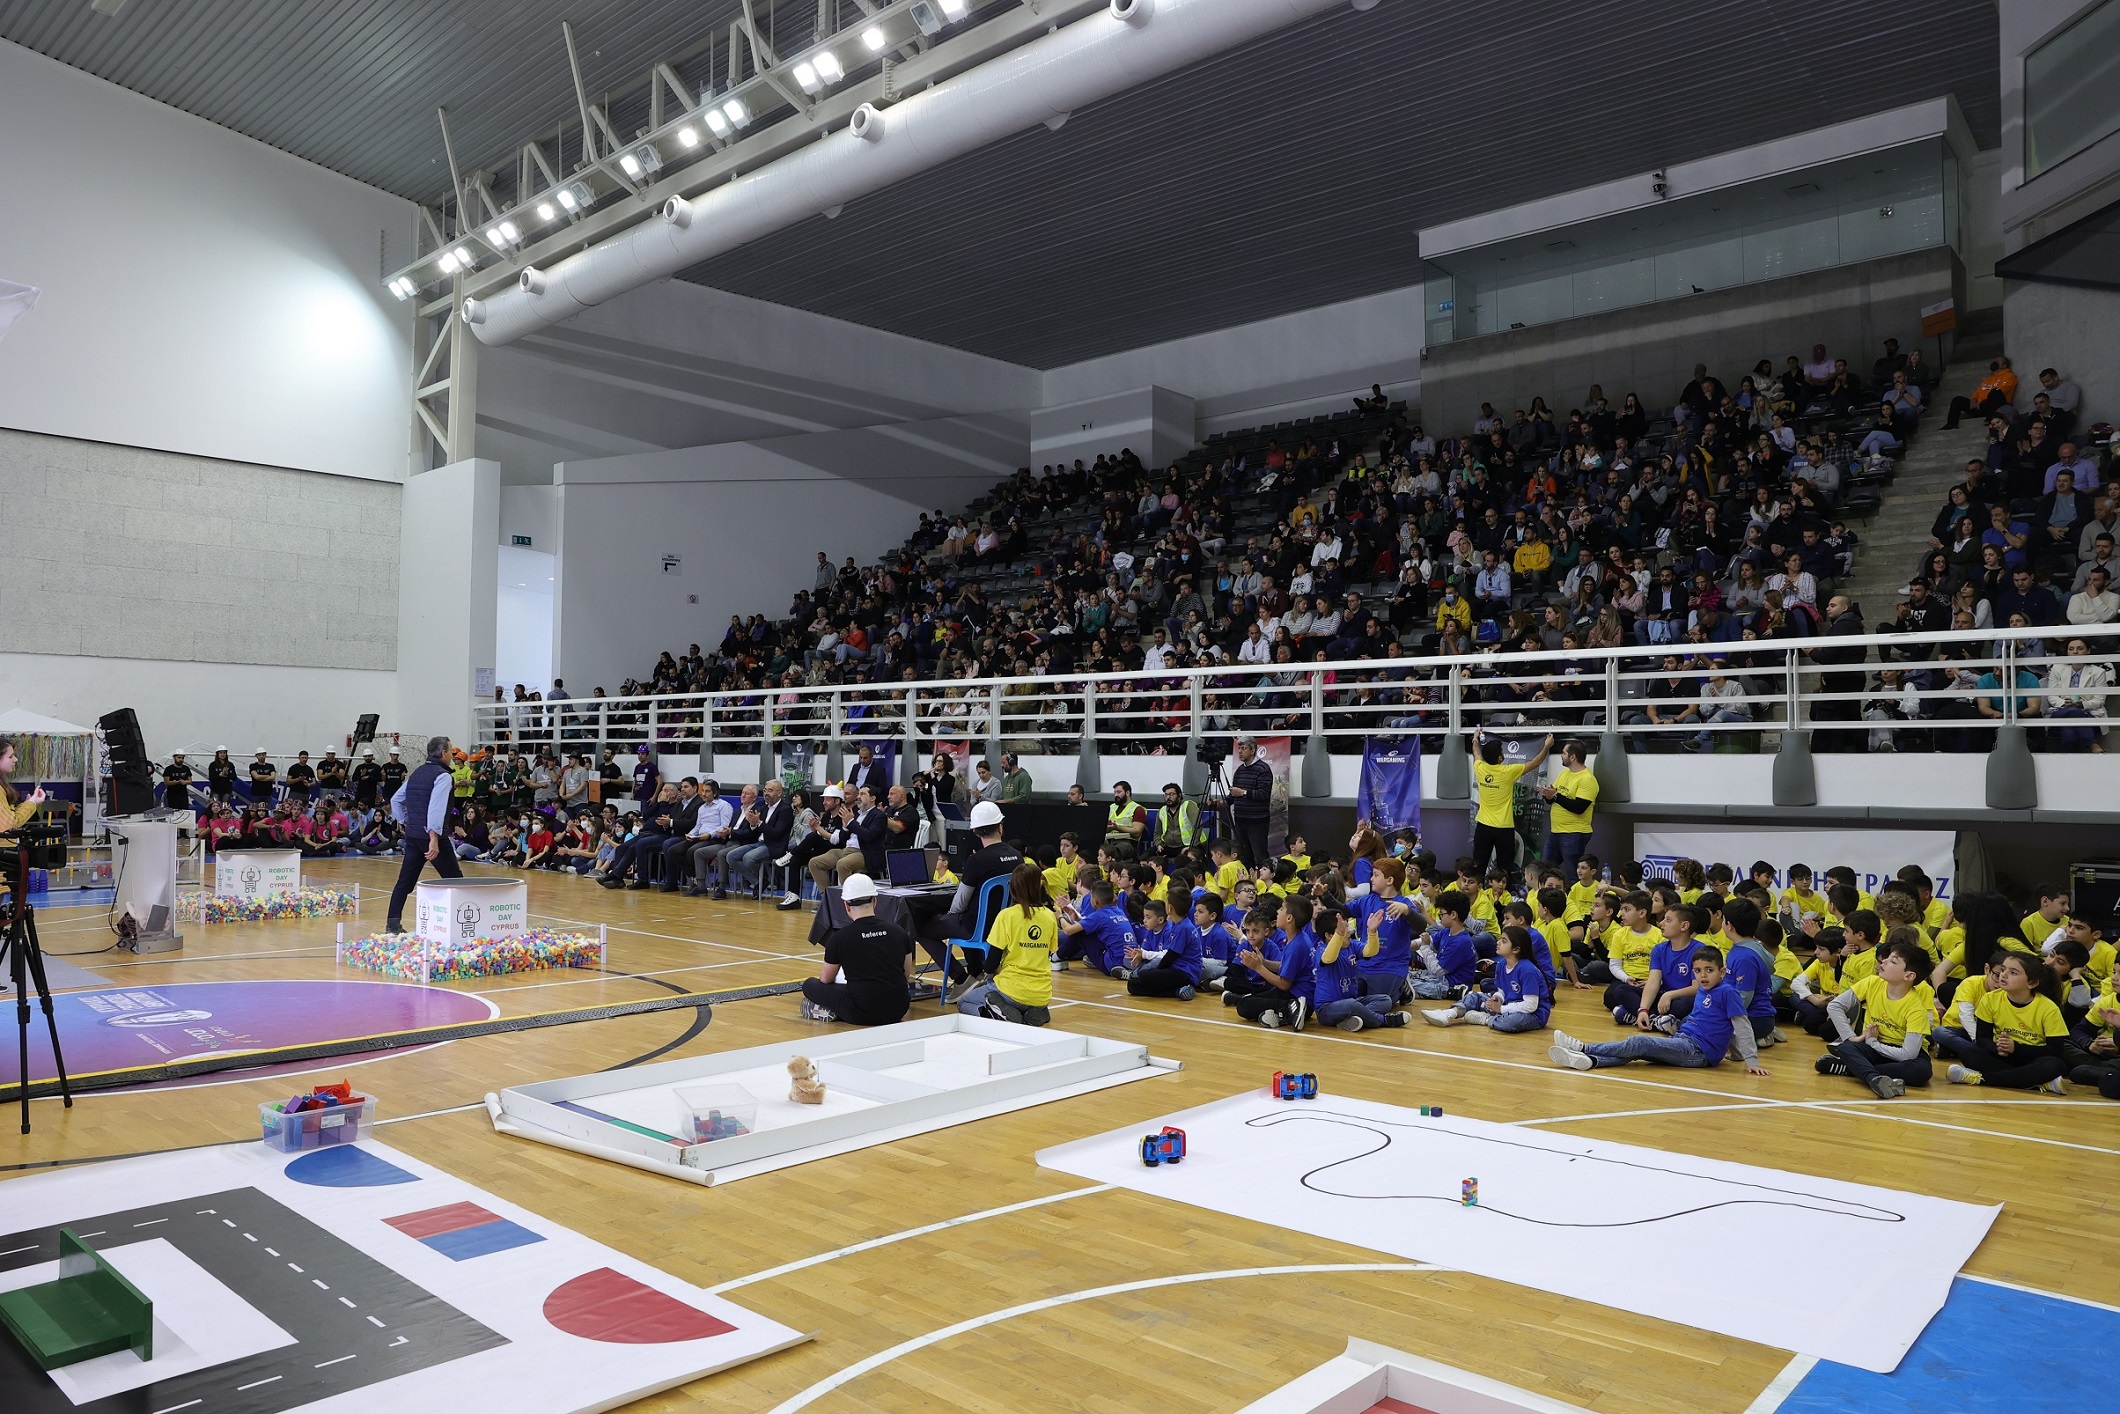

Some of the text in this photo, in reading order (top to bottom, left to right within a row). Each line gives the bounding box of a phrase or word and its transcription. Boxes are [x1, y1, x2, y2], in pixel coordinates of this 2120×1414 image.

[489, 904, 521, 912] ROBOTIC
[490, 923, 519, 931] CYPRUS
[861, 930, 888, 939] Referee
